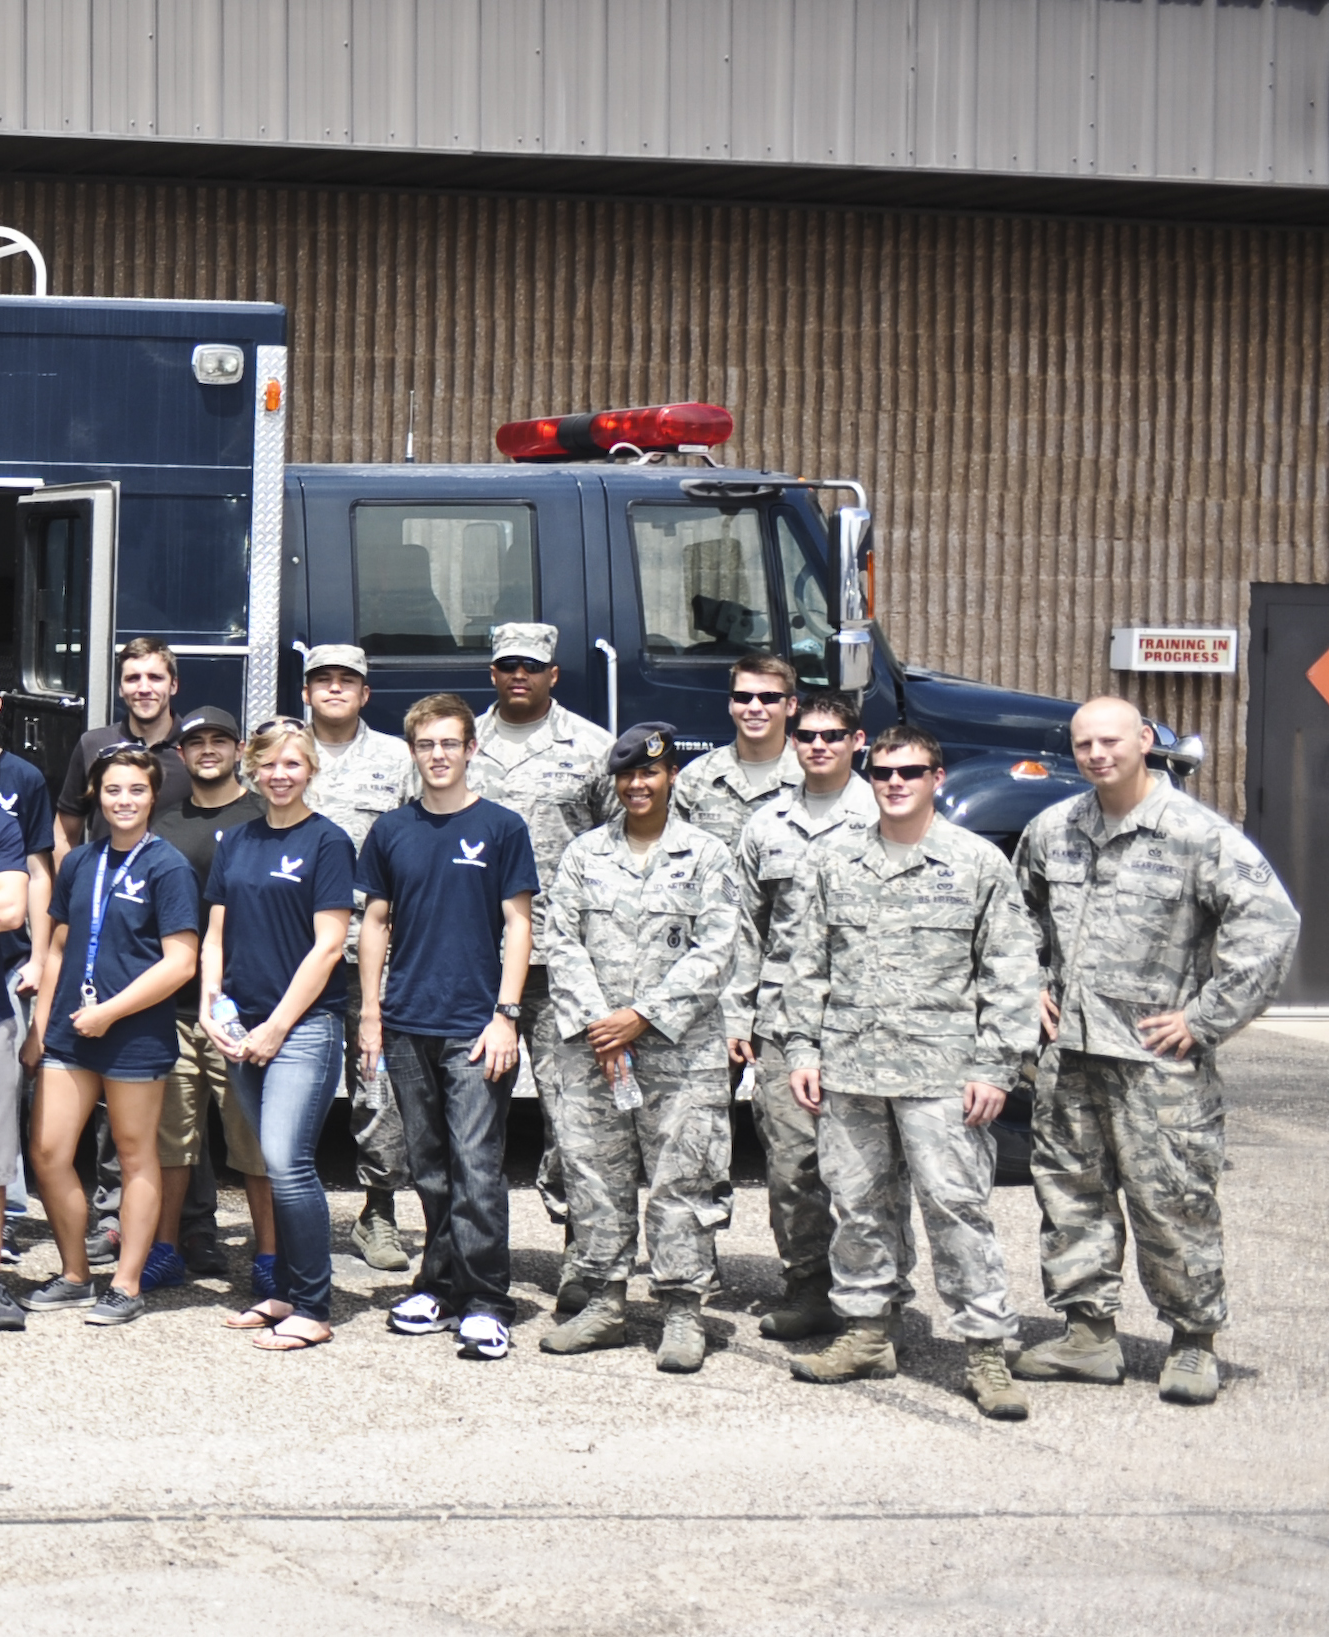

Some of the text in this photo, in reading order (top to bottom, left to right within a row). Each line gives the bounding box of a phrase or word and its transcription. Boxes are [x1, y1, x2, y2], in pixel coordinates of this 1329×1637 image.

[1139, 638, 1228, 651] TRAINING IN
[1144, 652, 1219, 663] PROGRESS
